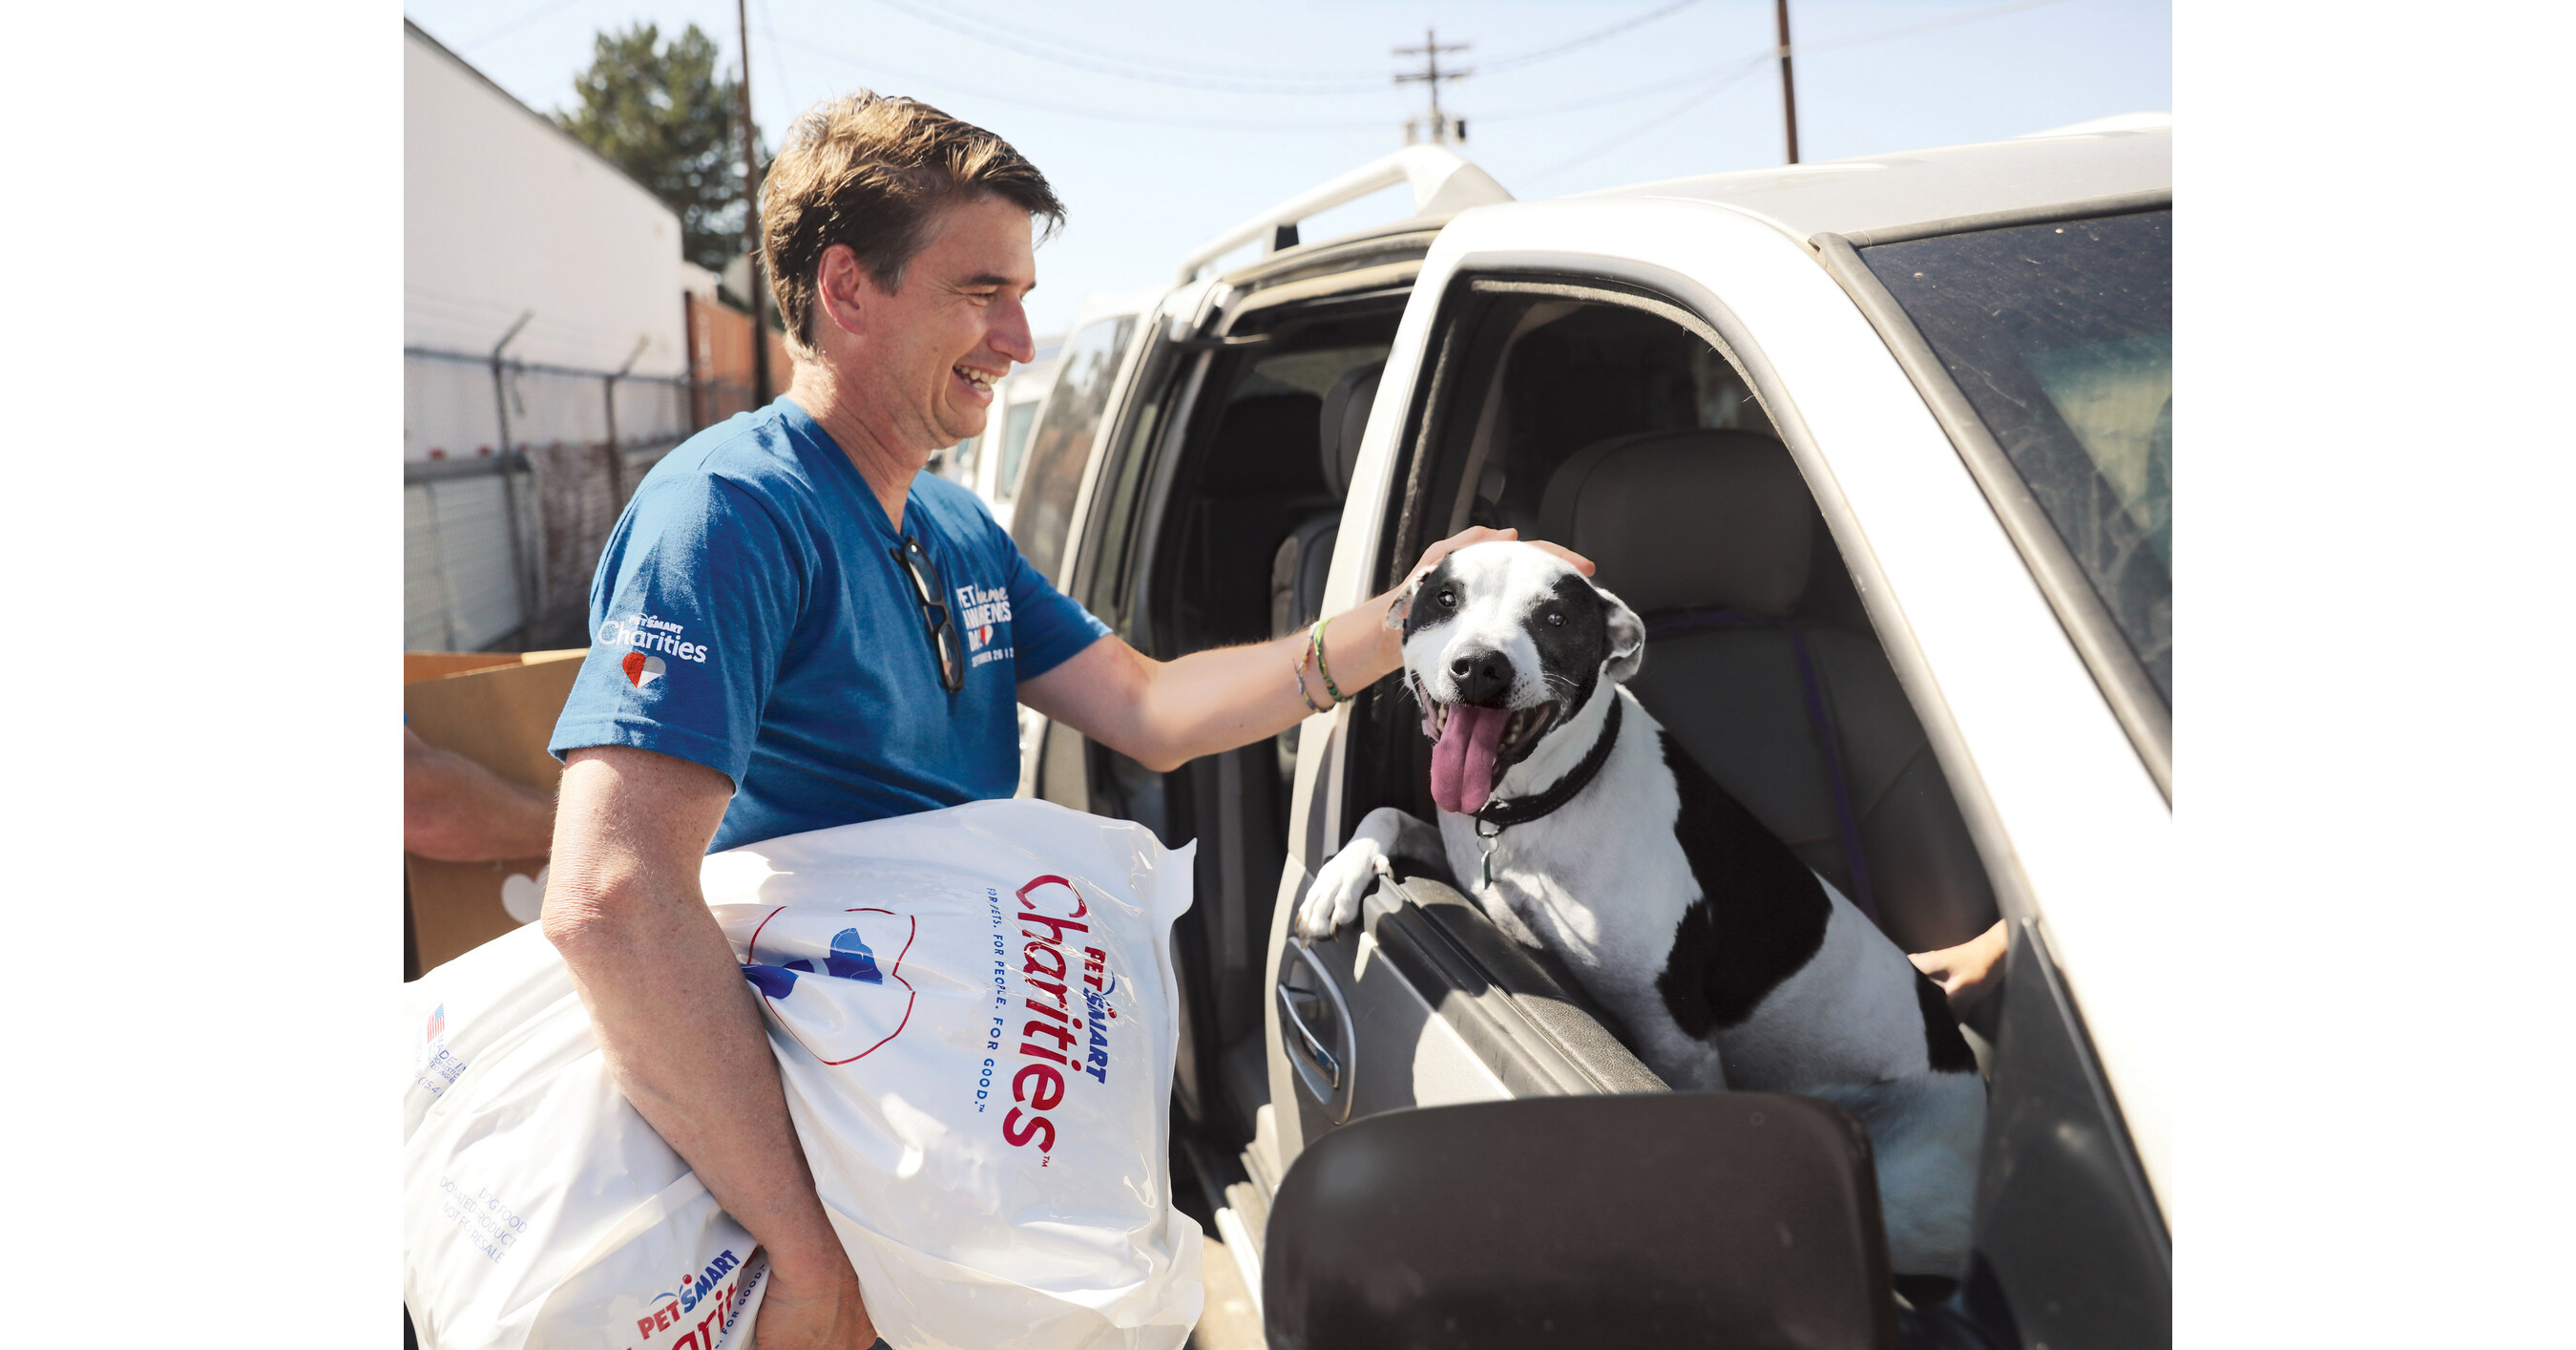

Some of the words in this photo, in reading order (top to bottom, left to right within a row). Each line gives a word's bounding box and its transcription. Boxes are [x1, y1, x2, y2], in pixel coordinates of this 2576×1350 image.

[598, 620, 708, 664] Charities
[986, 887, 998, 903] FOR
[994, 935, 1004, 956] FOR
[995, 960, 1006, 1009] PEOPLE.
[987, 1017, 1003, 1050] FOR
[1083, 945, 1115, 1085] PETSMART
[443, 1201, 461, 1222] NOT
[470, 1229, 506, 1264] RESALE
[496, 1205, 527, 1234] FOOD
[637, 1250, 741, 1340] PETSMART
[722, 1311, 739, 1335] FOR
